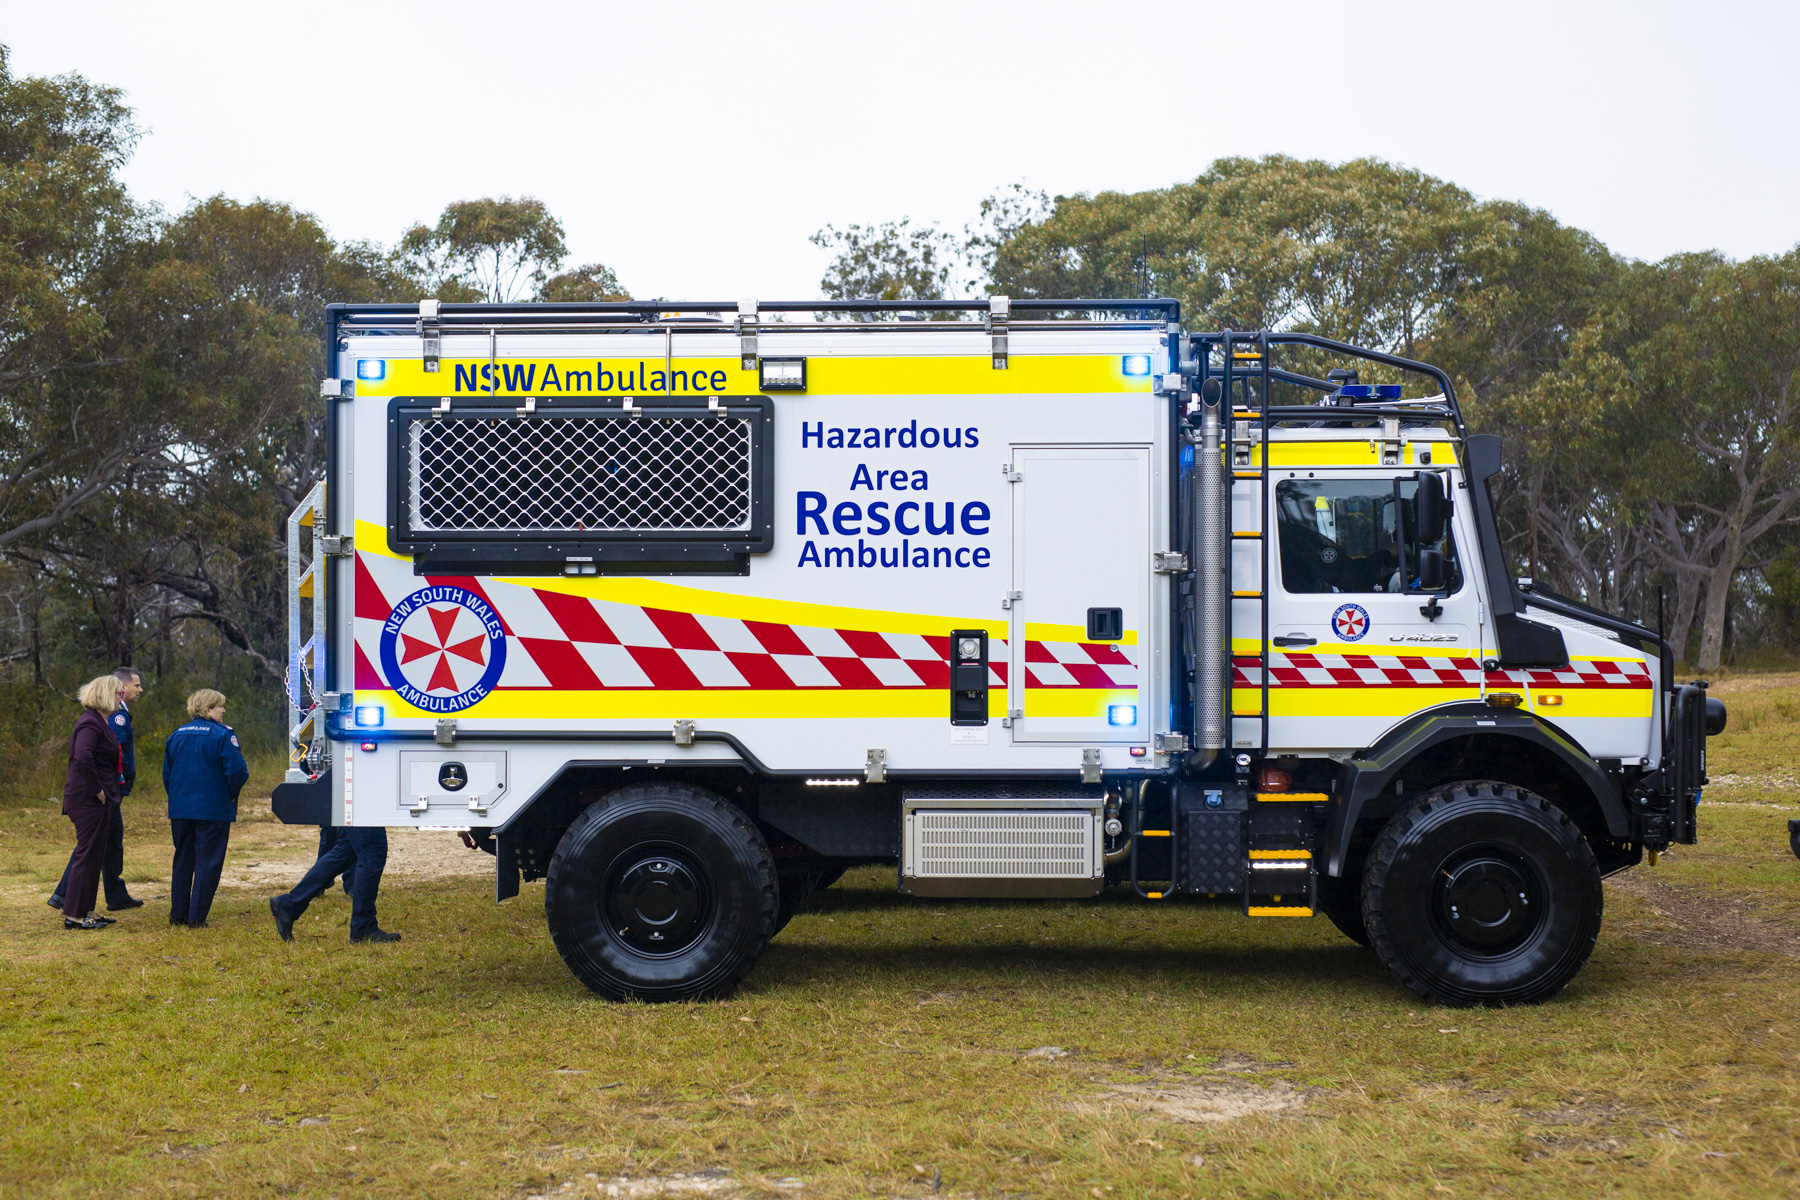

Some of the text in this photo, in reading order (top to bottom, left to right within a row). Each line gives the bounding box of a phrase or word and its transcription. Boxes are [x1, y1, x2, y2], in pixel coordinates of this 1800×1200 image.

[454, 361, 727, 392] NSW Ambulance
[802, 419, 979, 449] Hazardous
[850, 463, 929, 491] Area
[796, 490, 991, 536] Rescue
[797, 538, 991, 568] Ambulance
[385, 587, 503, 640] NEW SOUTH WALES
[1332, 608, 1341, 619] NEW
[1337, 632, 1365, 642] AMBULANCE
[397, 684, 488, 711] AMBULANCE
